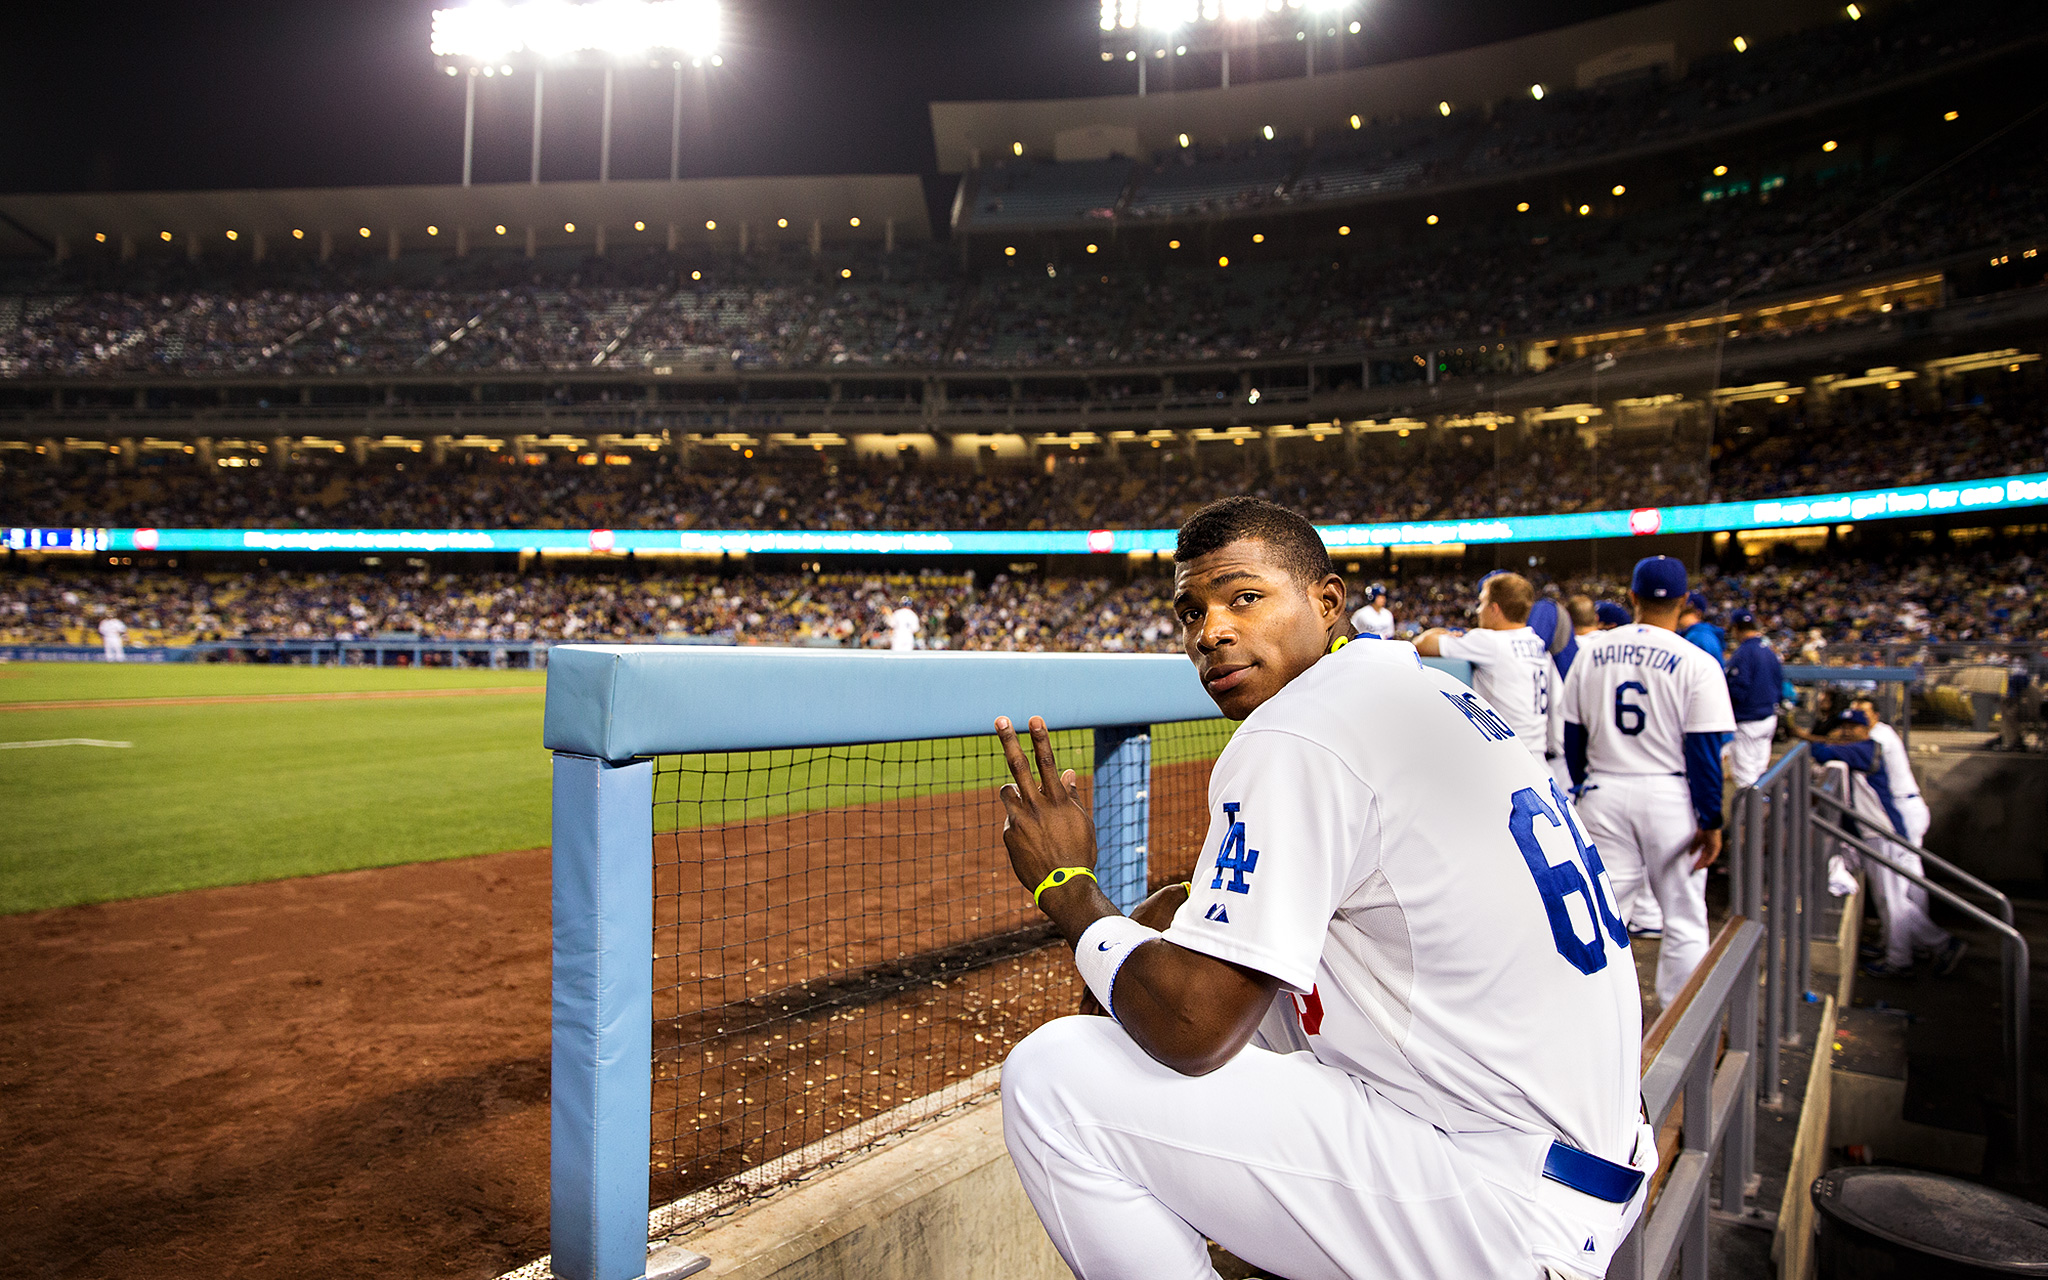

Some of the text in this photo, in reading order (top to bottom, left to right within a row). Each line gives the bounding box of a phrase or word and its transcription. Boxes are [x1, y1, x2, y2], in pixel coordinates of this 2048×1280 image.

[1592, 644, 1682, 675] HAIRSTON
[1534, 669, 1548, 715] 18
[1615, 681, 1648, 736] 6
[1210, 802, 1260, 895] LA
[1508, 777, 1631, 976] 66
